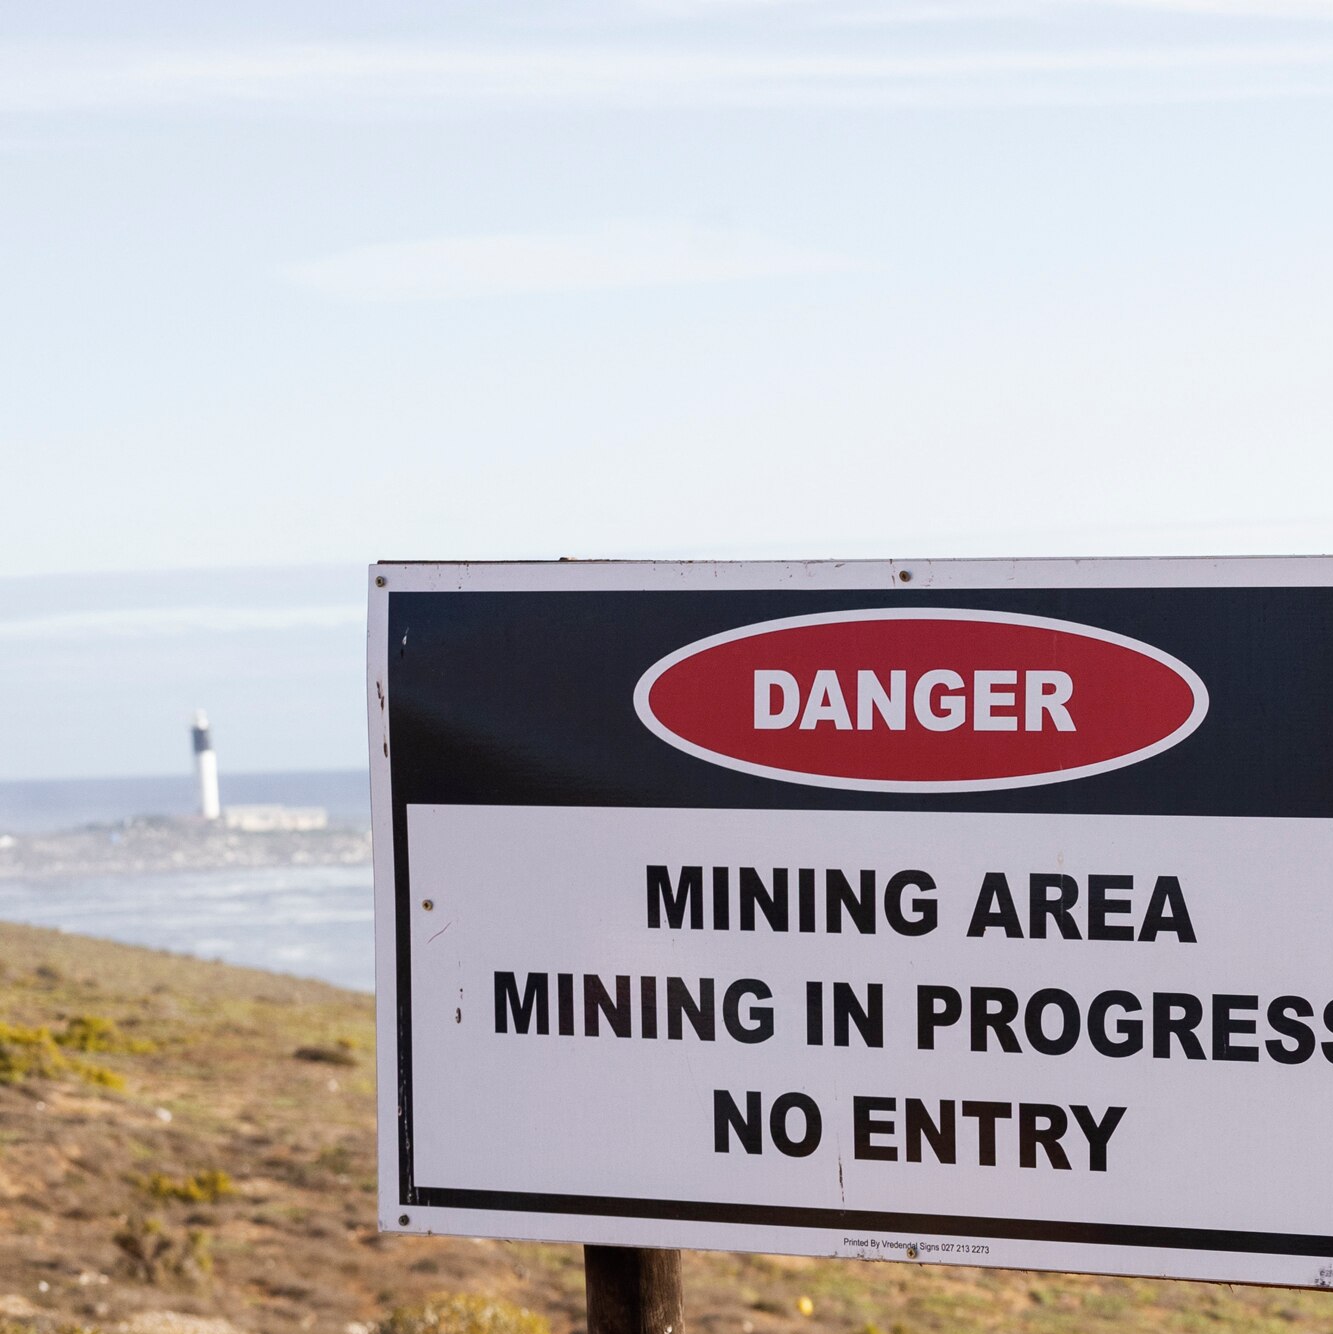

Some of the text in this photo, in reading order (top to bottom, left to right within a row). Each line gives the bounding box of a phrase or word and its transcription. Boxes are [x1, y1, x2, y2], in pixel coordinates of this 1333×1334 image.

[754, 669, 1076, 731] DANGER
[647, 865, 1197, 943] MINING AREA
[494, 971, 774, 1044] MINING
[807, 981, 883, 1048] IN
[714, 1090, 1127, 1171] NO ENTRY
[843, 1237, 990, 1255] Printed By Vredendal Signs 027 213 2273
